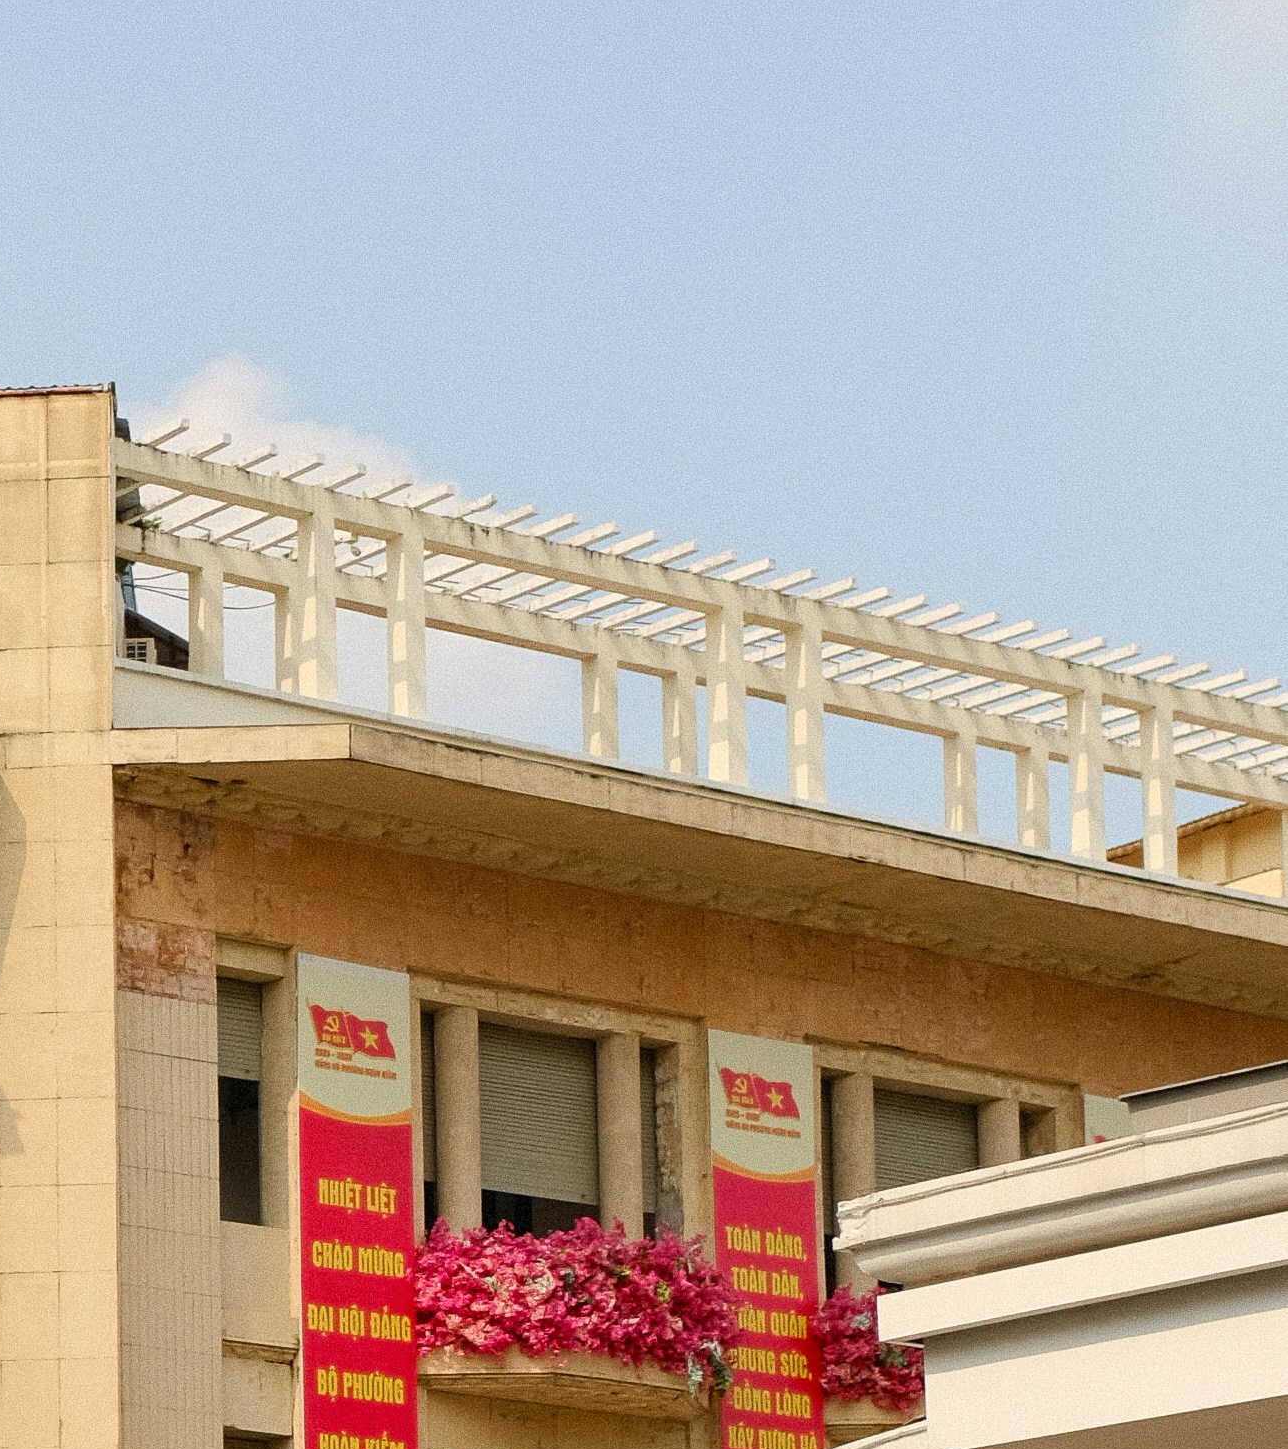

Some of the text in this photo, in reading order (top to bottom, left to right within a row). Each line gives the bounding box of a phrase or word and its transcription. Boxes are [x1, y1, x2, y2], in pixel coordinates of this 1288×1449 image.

[318, 1177, 397, 1218] NHIỆT LIỆT
[312, 1238, 405, 1278] CHÀO MỪNG
[307, 1303, 411, 1342] ĐẠI HỘI ĐẢNG
[317, 1365, 404, 1405] BỘ PHƯỜNG
